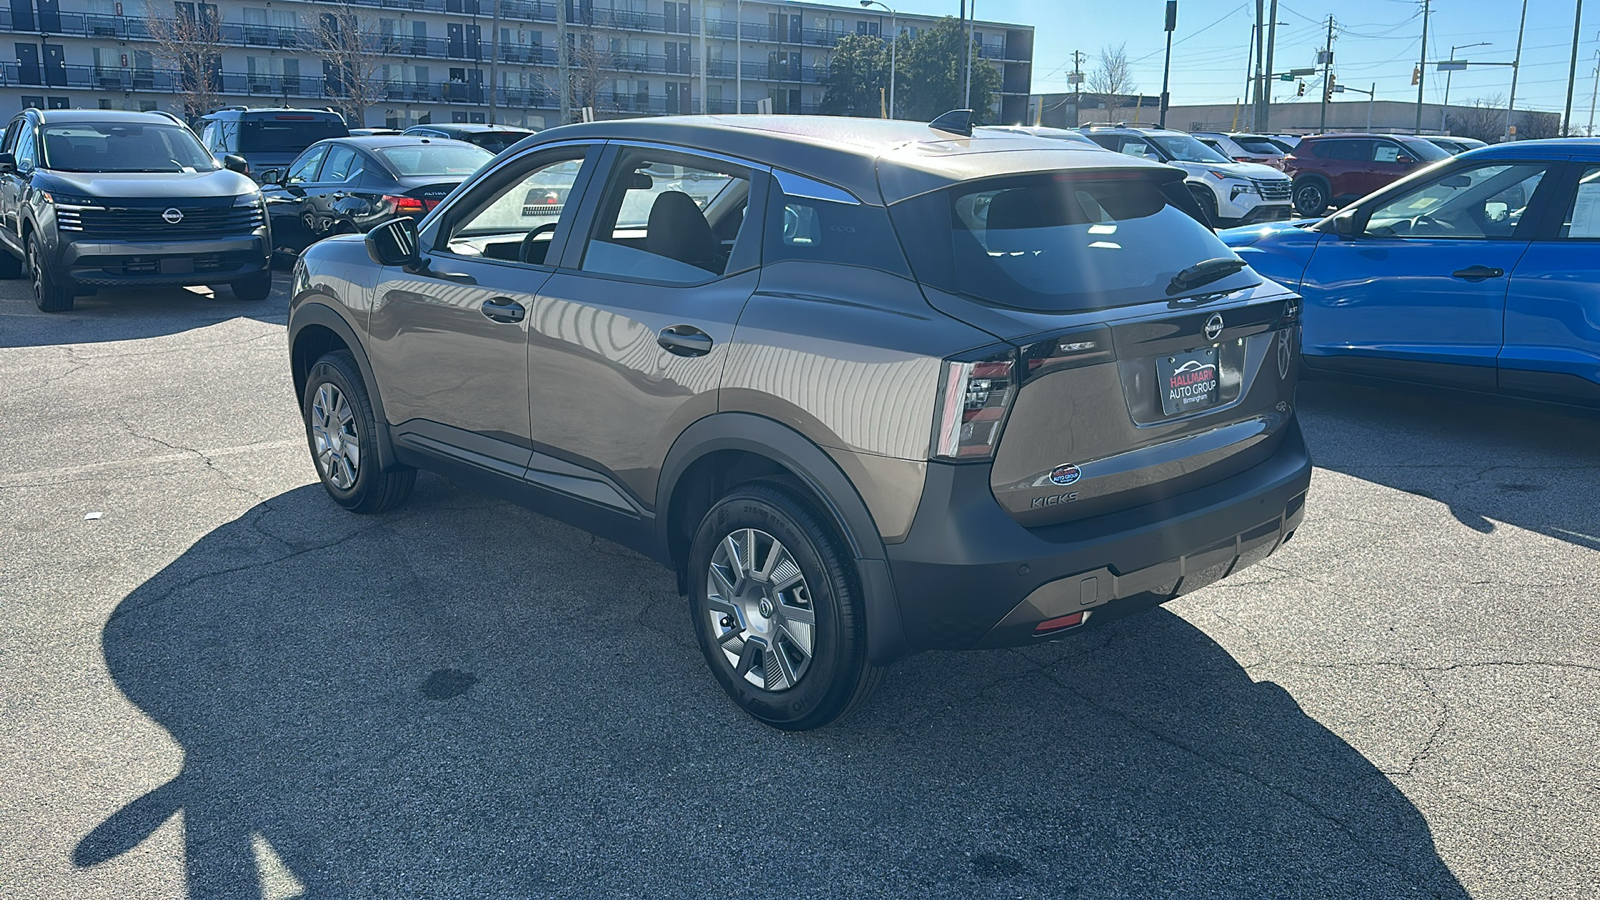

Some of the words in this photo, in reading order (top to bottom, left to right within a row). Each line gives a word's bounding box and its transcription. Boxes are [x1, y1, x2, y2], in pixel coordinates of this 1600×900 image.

[1170, 369, 1214, 388] HALLMARK
[1170, 385, 1192, 400] AUTO
[1192, 379, 1217, 395] GROUP
[1183, 394, 1208, 404] Birmingham
[1031, 491, 1079, 508] KICKS
